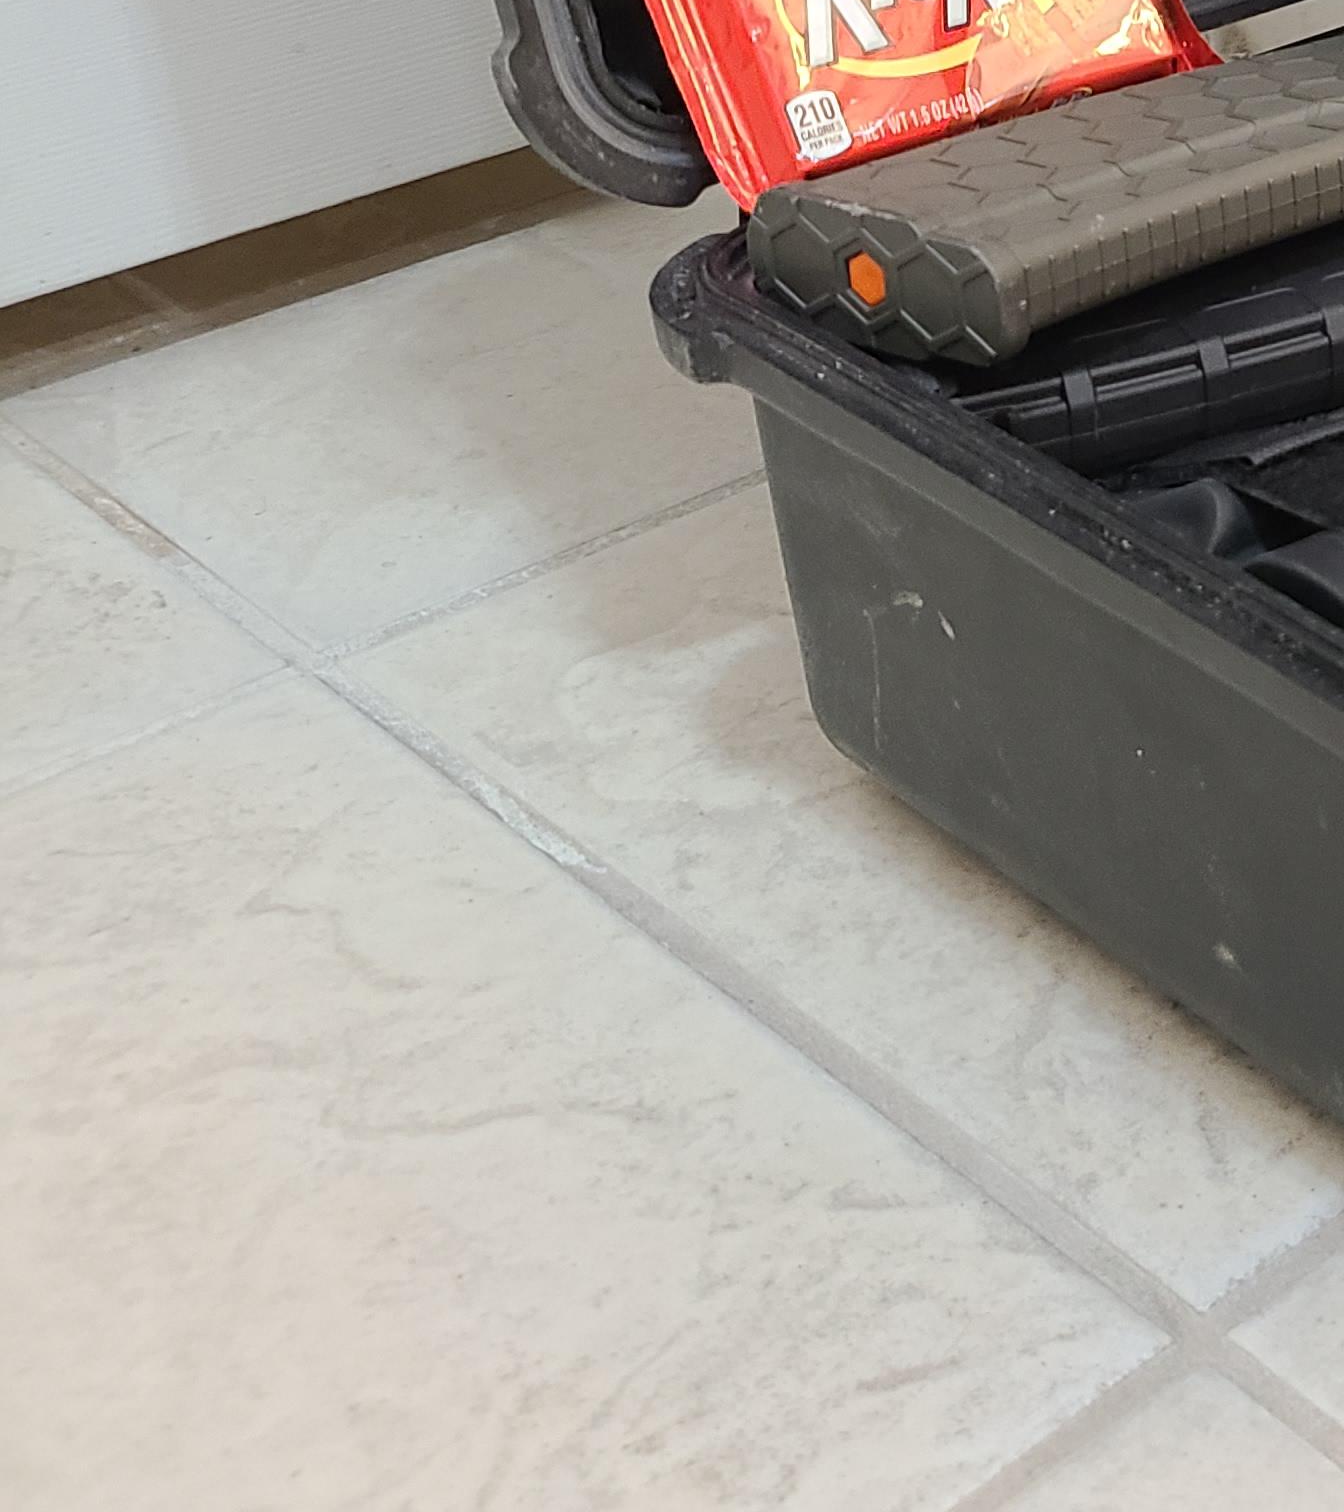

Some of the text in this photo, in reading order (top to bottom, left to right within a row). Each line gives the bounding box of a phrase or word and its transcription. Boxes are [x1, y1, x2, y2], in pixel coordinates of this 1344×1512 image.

[794, 96, 836, 128] 210
[886, 110, 909, 135] WT
[930, 98, 951, 122] OZ
